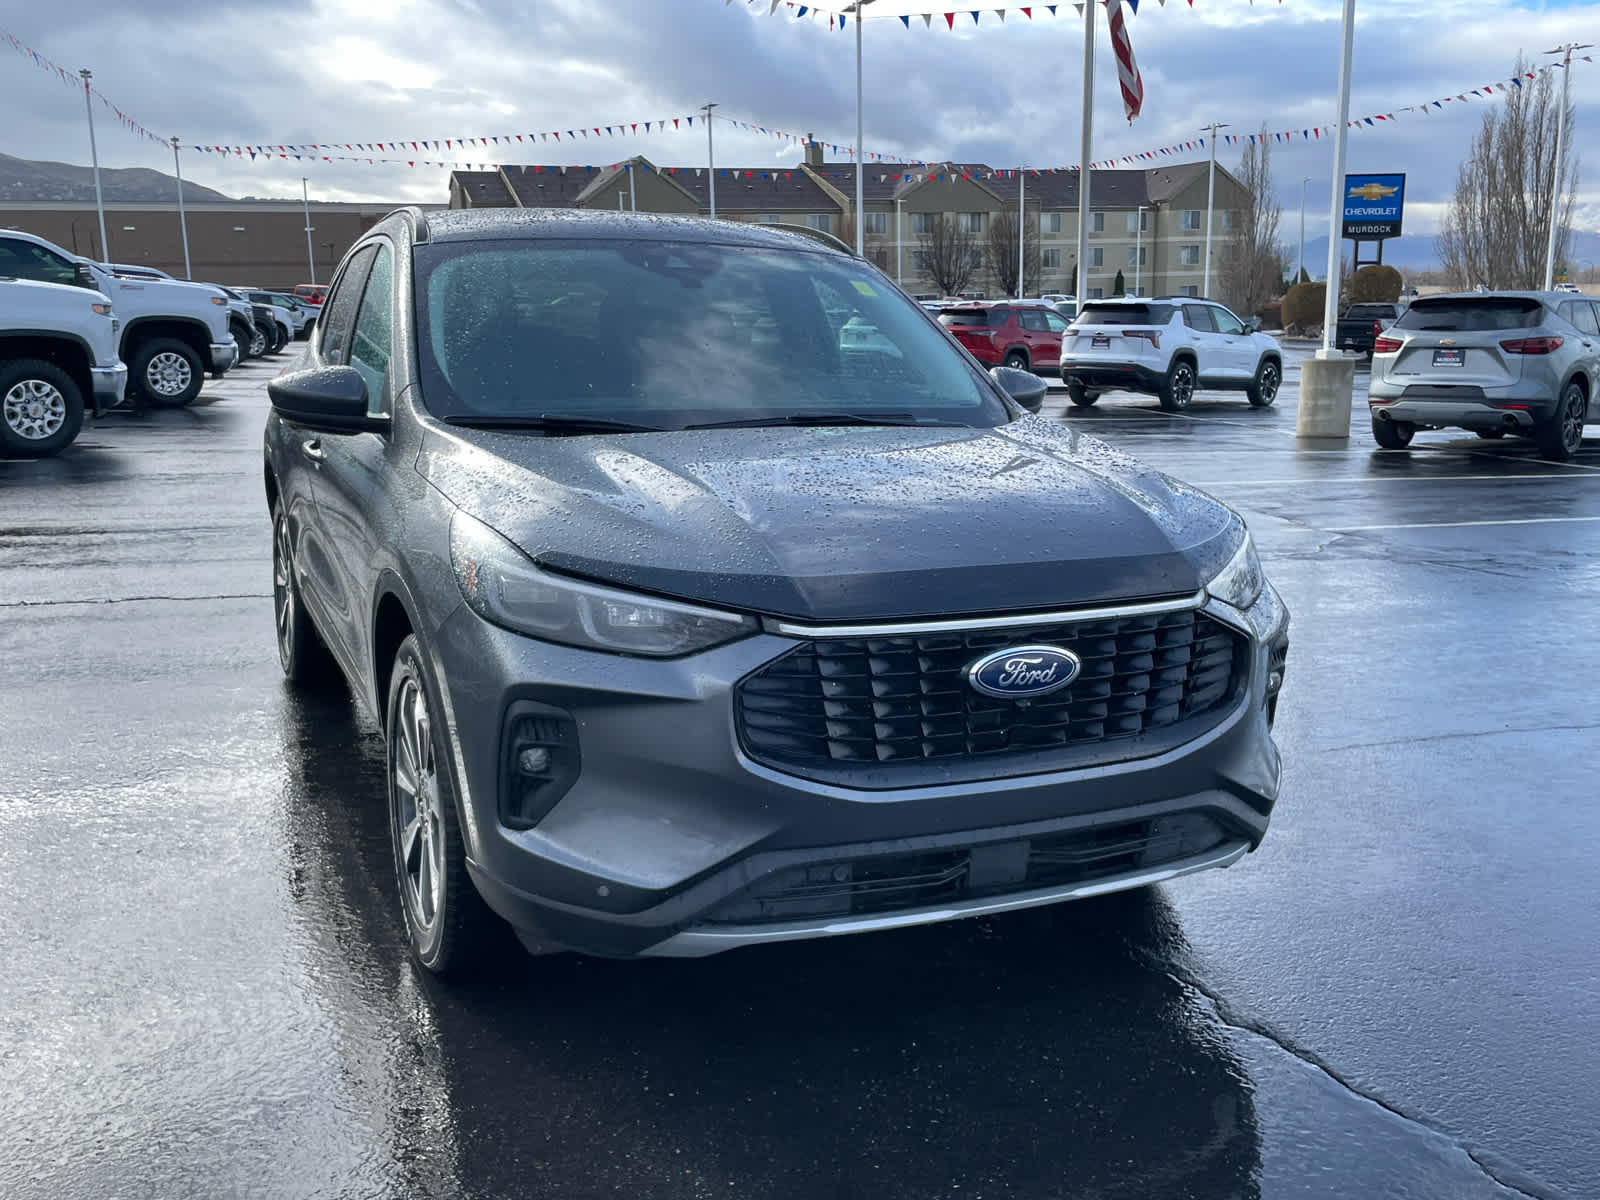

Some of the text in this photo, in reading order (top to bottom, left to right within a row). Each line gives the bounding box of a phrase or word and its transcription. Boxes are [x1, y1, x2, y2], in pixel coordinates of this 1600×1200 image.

[1344, 207, 1397, 216] CHEVROLET
[1348, 225, 1391, 233] MURDOCK
[998, 657, 1058, 687] Ford
